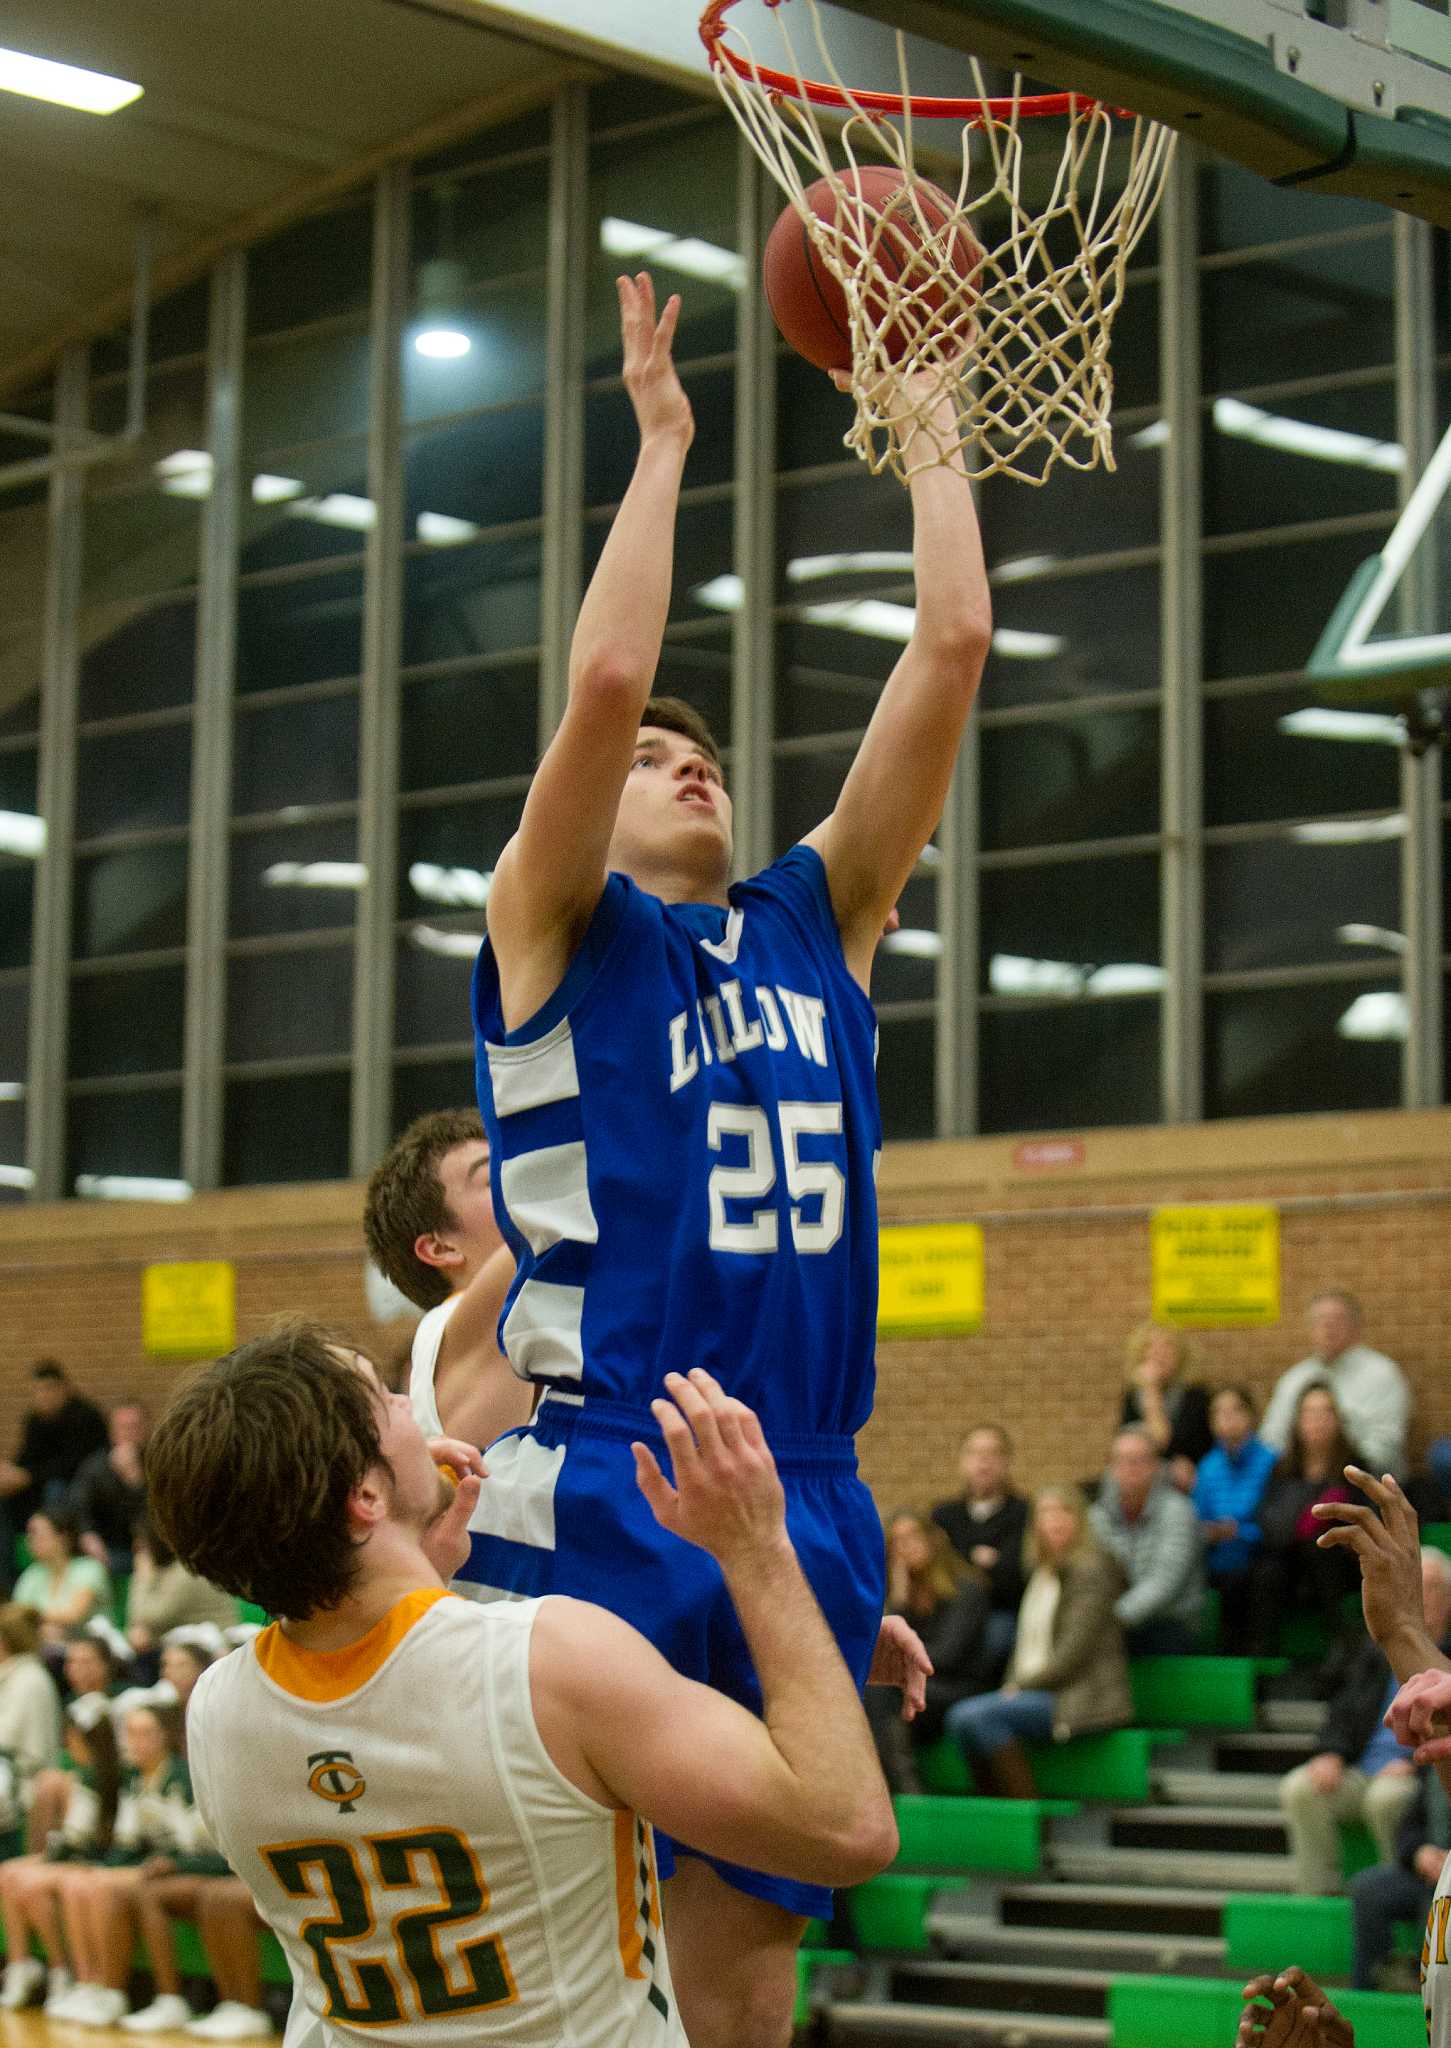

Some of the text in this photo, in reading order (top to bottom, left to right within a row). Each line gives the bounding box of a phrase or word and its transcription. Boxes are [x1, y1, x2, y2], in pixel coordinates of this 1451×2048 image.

[669, 978, 828, 1093] LLOW
[707, 1101, 845, 1254] 25
[258, 1825, 520, 2028] 22
